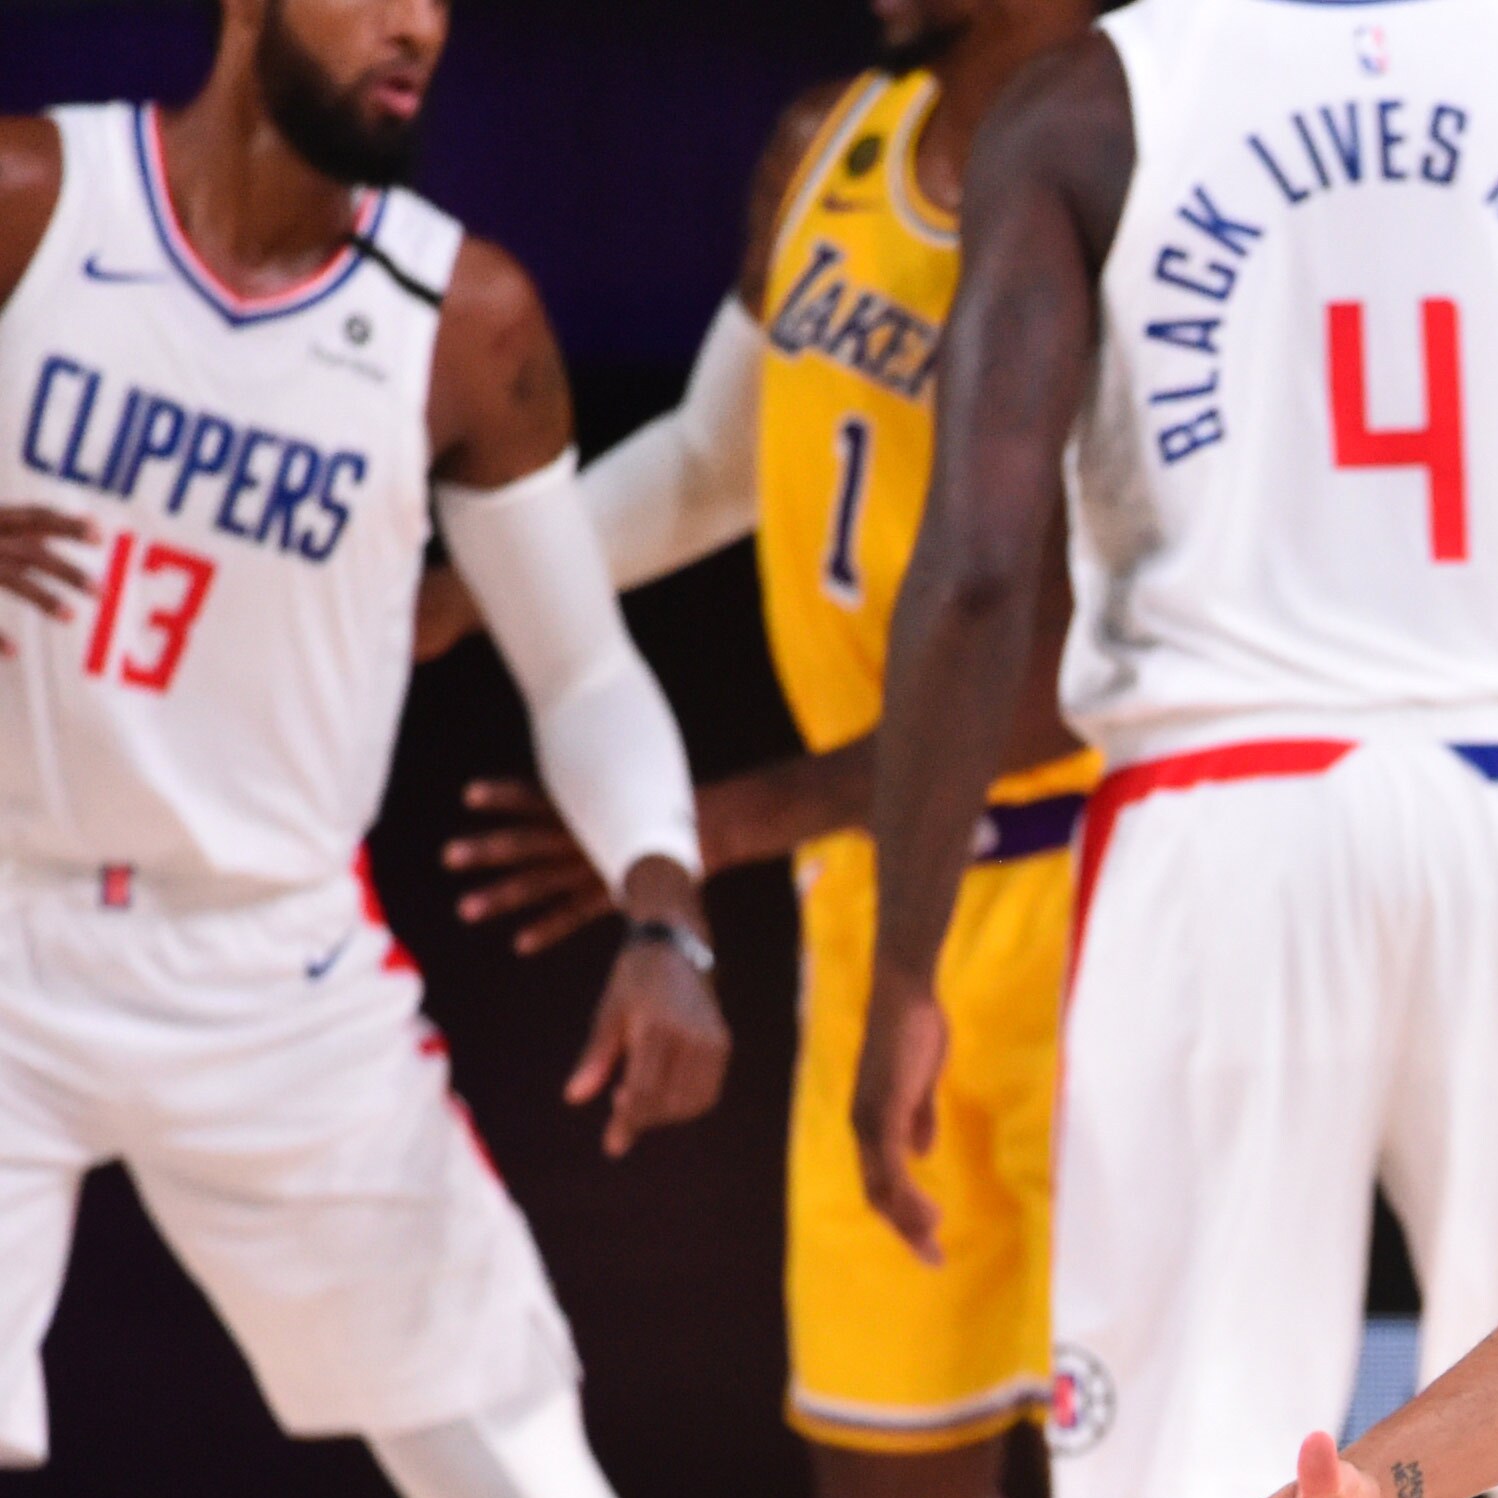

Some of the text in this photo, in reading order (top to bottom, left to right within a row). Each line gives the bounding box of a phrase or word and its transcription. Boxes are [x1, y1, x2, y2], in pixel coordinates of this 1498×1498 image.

[1145, 183, 1263, 467] BLACK
[1245, 98, 1469, 205] LIVES
[20, 353, 369, 567] CLIPPERS
[822, 415, 868, 607] 1
[1325, 295, 1469, 563] 4
[85, 532, 217, 696] 13
